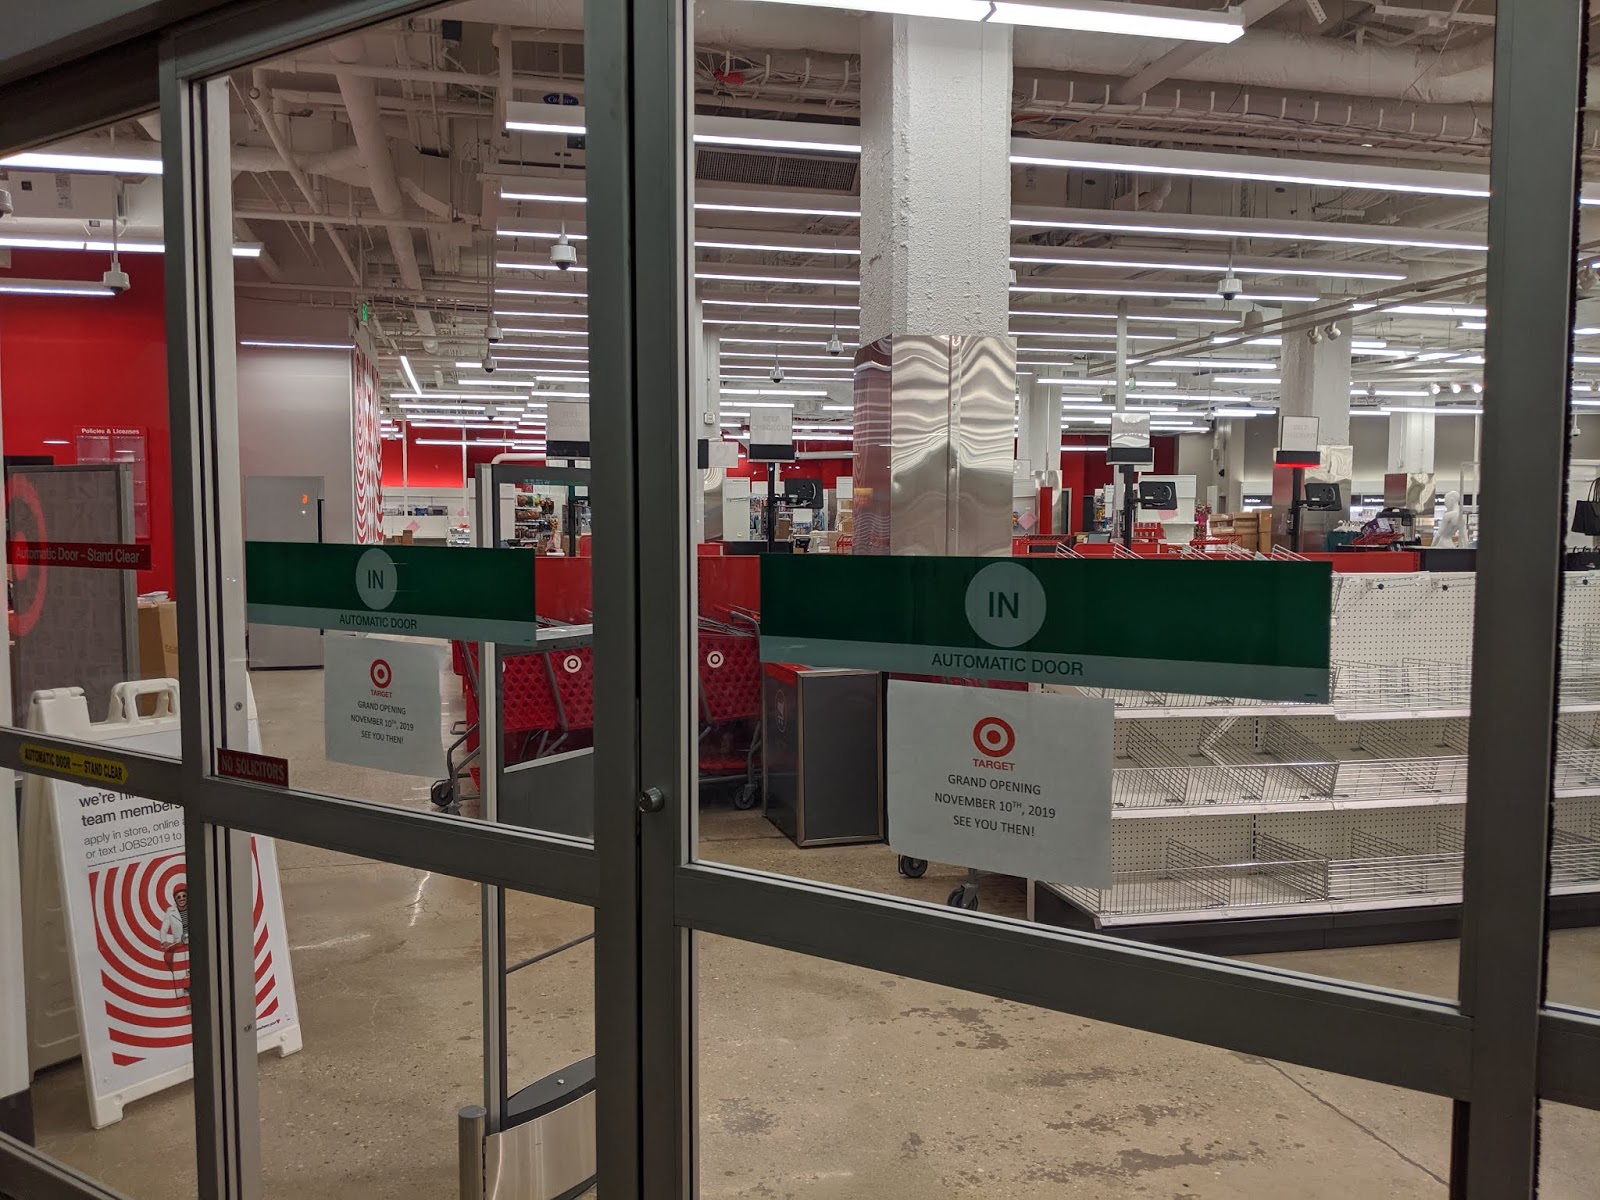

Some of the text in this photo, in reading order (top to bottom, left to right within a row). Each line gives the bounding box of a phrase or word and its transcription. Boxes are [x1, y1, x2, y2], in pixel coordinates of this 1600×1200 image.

[547, 95, 574, 104] Caier
[16, 546, 57, 560] Automatic
[57, 546, 79, 561] Door
[87, 547, 114, 562] Stand
[114, 548, 140, 564] Clear
[367, 569, 384, 590] IN
[988, 591, 1019, 619] IN
[339, 613, 418, 631] AUTOMATIC DOOR
[931, 652, 1084, 677] AUTOMATIC DOOR
[370, 689, 393, 698] TARGET
[357, 700, 407, 716] GRAND OPENING
[350, 714, 384, 727] NOVEMBER
[399, 721, 414, 732] 2019
[361, 730, 404, 745] SEE YOU THEN!
[24, 747, 55, 767] AUTOMATIC
[55, 754, 72, 770] DOOR
[83, 759, 103, 777] STAND
[103, 763, 123, 781] CLEAR
[220, 754, 285, 782] NO SOLICITORS
[972, 758, 1016, 772] TARGET
[947, 773, 1042, 796] GRAND OPENING
[934, 792, 997, 812] NOVEMBER
[1027, 805, 1056, 819] 2019
[81, 811, 117, 827] team
[952, 814, 1035, 837] SEE YOU THEN!
[84, 832, 112, 847] apply
[112, 830, 122, 840] in
[123, 824, 151, 838] store,
[152, 818, 180, 832] online
[85, 831, 183, 860] or text JOBS2019 to
